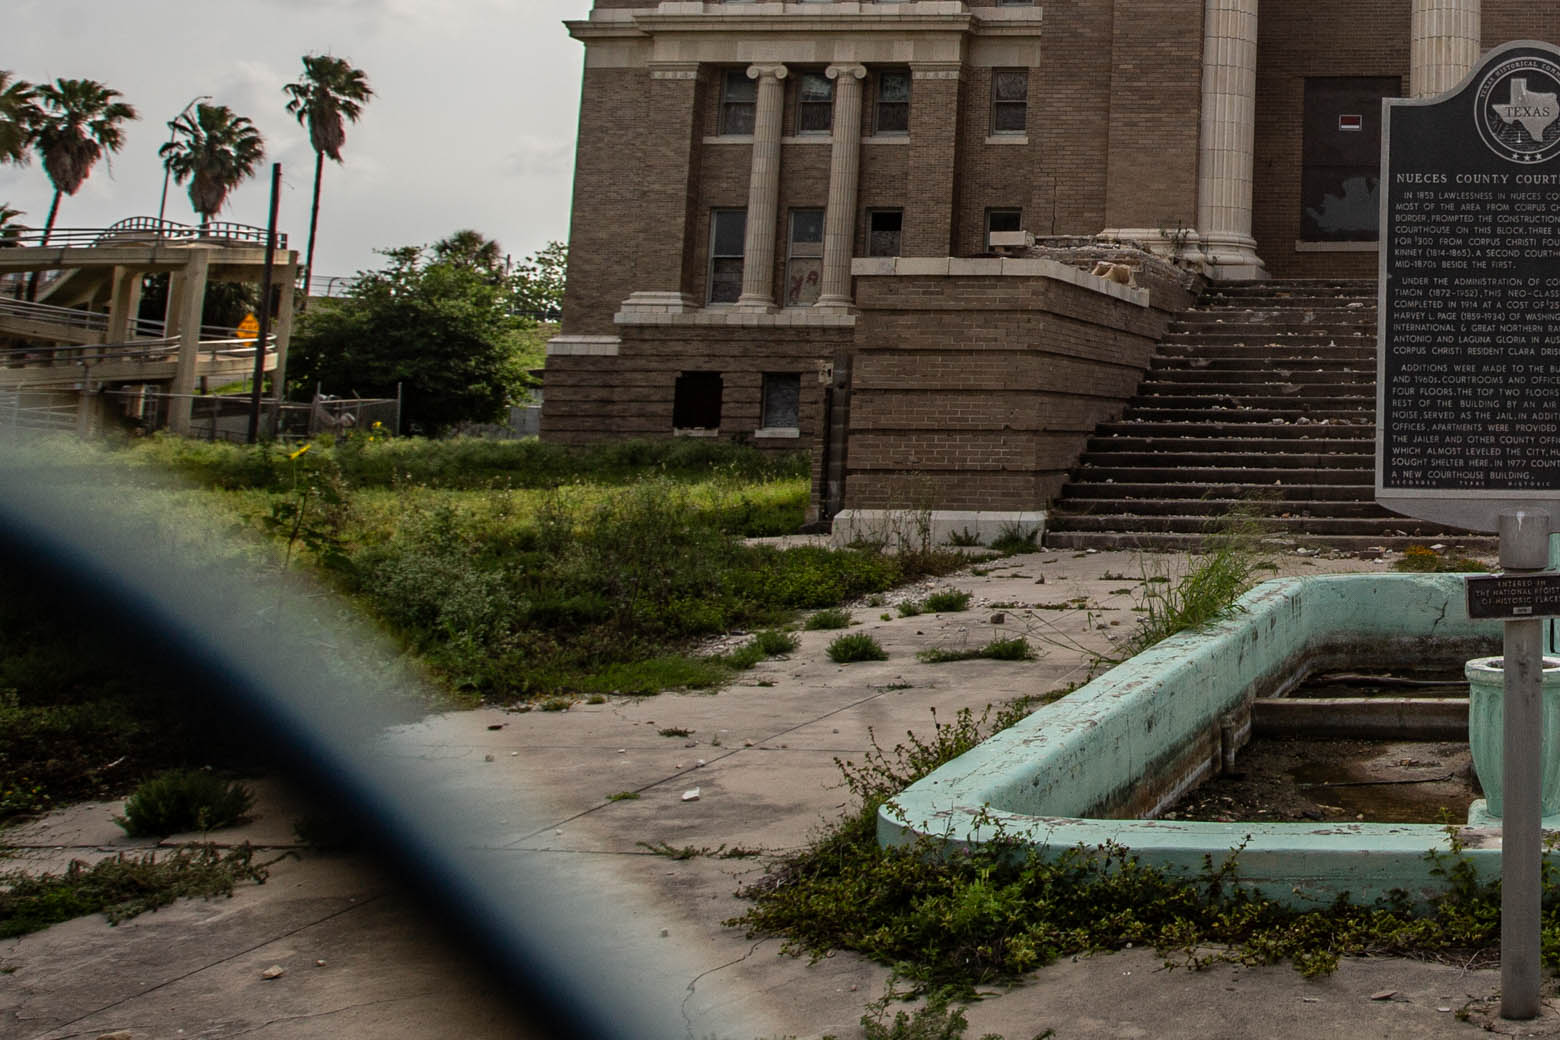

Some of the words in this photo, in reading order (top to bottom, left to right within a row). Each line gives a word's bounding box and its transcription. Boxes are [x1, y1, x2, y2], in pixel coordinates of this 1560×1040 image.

[1495, 60, 1538, 77] HISTORICAL
[1505, 107, 1550, 118] TEXAS
[1397, 173, 1448, 184] NUECES
[1456, 174, 1509, 184] COUNTY
[1439, 192, 1492, 200] LAWLESSNESS
[1510, 192, 1540, 201] NUECES
[1395, 202, 1418, 211] MOST
[1423, 203, 1435, 211] OF
[1460, 203, 1481, 211] AREA
[1486, 203, 1509, 212] FROM
[1515, 203, 1546, 212] CORPUS
[1478, 214, 1492, 223] THE
[1497, 215, 1560, 223] CONSTRUCTION
[1395, 226, 1449, 234] COURTHOUSE
[1457, 226, 1469, 235] ON
[1474, 226, 1491, 235] THIS
[1394, 237, 1411, 246] FOR
[1439, 237, 1462, 246] FROM
[1468, 238, 1500, 246] CORPUS
[1506, 238, 1536, 247] CHRISTI
[1486, 249, 1520, 258] SECOND
[1442, 260, 1467, 269] BESIDE
[1472, 260, 1486, 269] THE
[1402, 277, 1428, 286] UNDER
[1434, 277, 1448, 286] THE
[1454, 277, 1523, 286] ADMINISTRATION
[1528, 278, 1539, 287] OF
[1394, 300, 1443, 309] COMPLETED
[1448, 300, 1456, 309] IN
[1482, 300, 1492, 309] AT
[1506, 301, 1528, 310] COST
[1533, 301, 1544, 310] OF
[1394, 312, 1424, 320] HARVEY
[1437, 312, 1456, 321] PAGE
[1509, 313, 1520, 321] OF
[1393, 323, 1454, 332] INTERNATIONAL
[1471, 324, 1495, 333] GREAT
[1500, 324, 1542, 333] NORTHERN
[1393, 335, 1432, 343] ANTONIO
[1437, 335, 1454, 344] AND
[1459, 335, 1491, 344] LAGUNA
[1496, 335, 1525, 344] GLORIA
[1393, 346, 1426, 355] CORPUS
[1432, 346, 1462, 355] CHRISTI
[1467, 347, 1503, 356] RESIDENT
[1508, 347, 1535, 356] CLARA
[1401, 364, 1447, 372] ADDITIONS
[1454, 364, 1475, 373] WERE
[1483, 364, 1506, 373] MADE
[1512, 365, 1524, 373] TO
[1529, 365, 1544, 373] THE
[1393, 375, 1410, 384] AND
[1509, 376, 1526, 385] AND
[1392, 387, 1415, 396] FOUR
[1500, 388, 1520, 397] TWO
[1418, 399, 1430, 408] OF
[1437, 399, 1452, 408] THE
[1460, 400, 1500, 408] BUILDING
[1506, 400, 1517, 409] BY
[1461, 411, 1471, 420] AS
[1475, 411, 1490, 420] THE
[1488, 423, 1508, 432] WERE
[1516, 424, 1556, 433] PROVIDED
[1392, 435, 1407, 444] THE
[1413, 435, 1439, 444] JAILER
[1445, 435, 1462, 444] AND
[1467, 435, 1495, 444] OTHER
[1500, 436, 1534, 445] COUNTY
[1392, 446, 1421, 455] WHICH
[1427, 447, 1461, 456] ALMOST
[1466, 447, 1501, 456] LEVELED
[1506, 447, 1520, 456] THE
[1391, 458, 1427, 467] SOUGHT
[1431, 458, 1464, 467] SHELTER
[1427, 471, 1483, 479] COURTHOUSE
